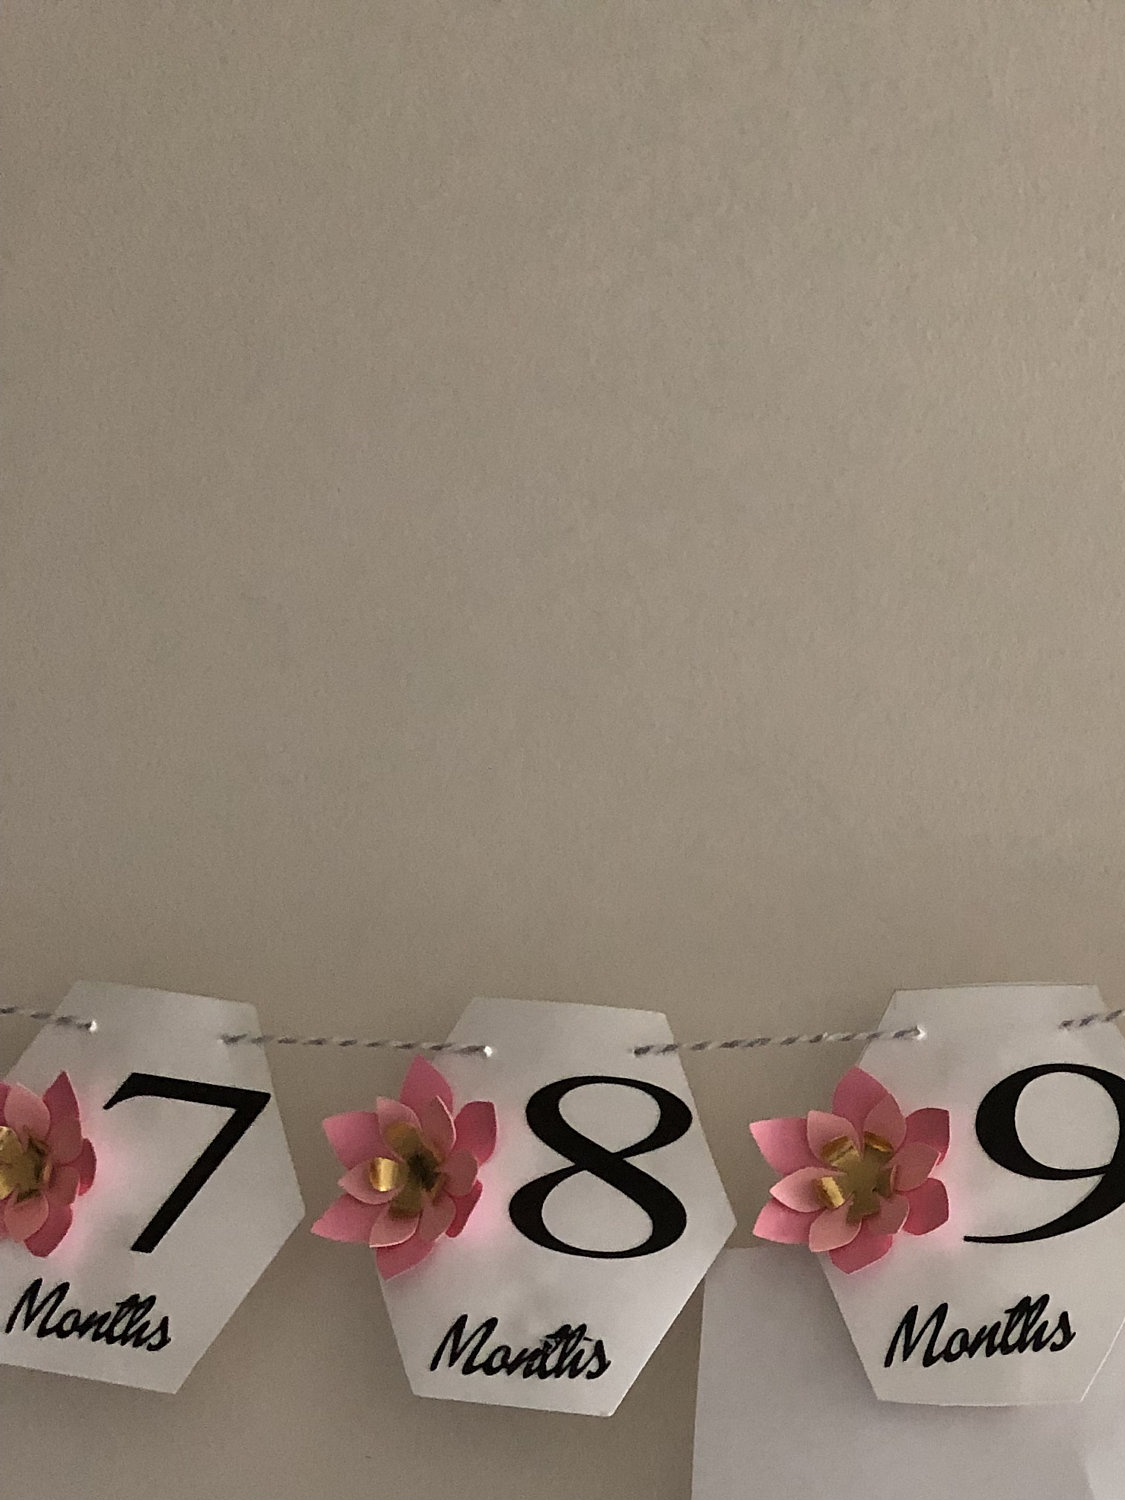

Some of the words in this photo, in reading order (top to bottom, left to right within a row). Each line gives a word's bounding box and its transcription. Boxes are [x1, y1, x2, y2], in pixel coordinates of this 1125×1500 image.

[103, 1072, 271, 1254] 7
[508, 1075, 693, 1260] 8
[4, 1277, 172, 1352] Months
[429, 1313, 612, 1380] Months
[883, 1293, 1077, 1368] Months
